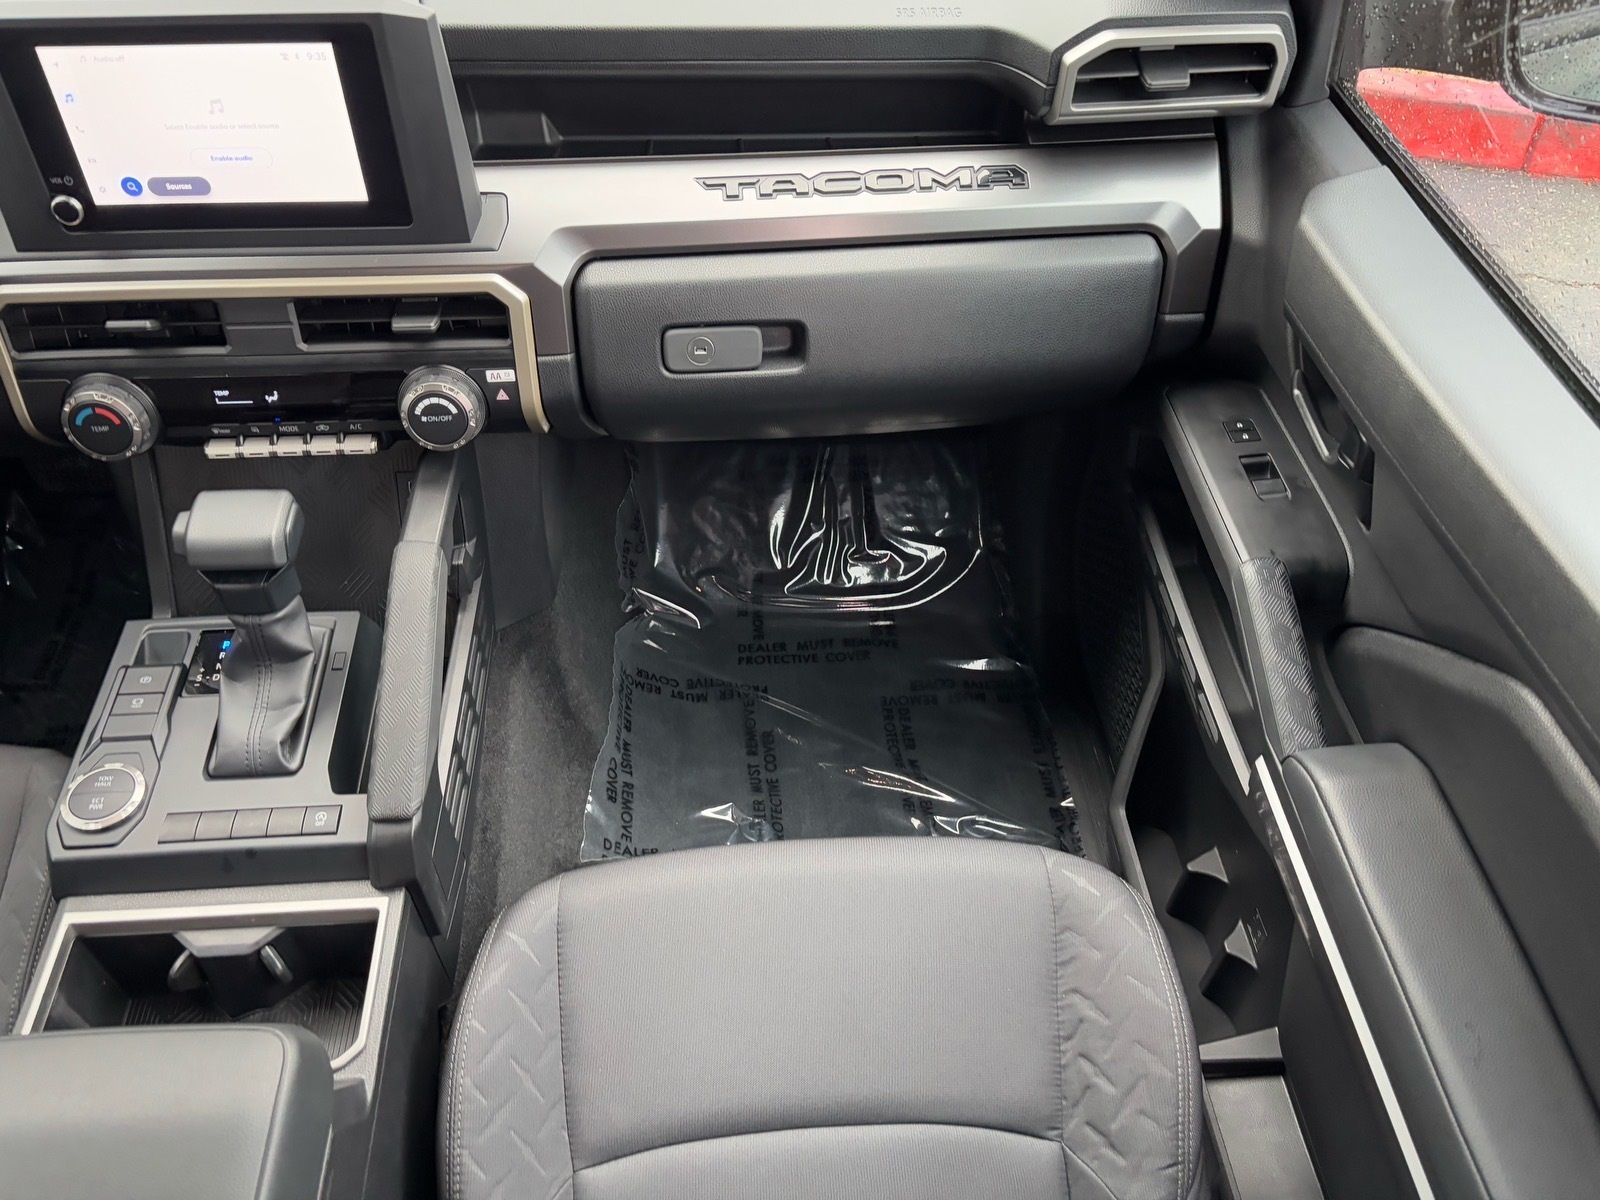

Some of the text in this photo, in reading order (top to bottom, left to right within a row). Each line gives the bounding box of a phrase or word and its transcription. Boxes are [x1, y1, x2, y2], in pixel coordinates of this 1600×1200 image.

[306, 52, 327, 62] 9:35
[210, 154, 233, 163] Enable
[166, 182, 192, 191] Sources
[693, 164, 1031, 201] TACOMA
[427, 414, 453, 423] ON/OFF
[91, 425, 110, 433] TEMP
[279, 425, 299, 433] MODE
[222, 640, 230, 649] P
[737, 641, 787, 654] DEALER
[796, 638, 835, 651] MUST
[737, 650, 871, 666] PROTECTIVE COVER
[636, 666, 680, 688] COVER
[898, 707, 917, 751] DEALER
[621, 738, 634, 777] MUST
[606, 757, 618, 804] COVER
[762, 730, 785, 840] ROTECTIVE COVER
[620, 780, 635, 843] REMOVE
